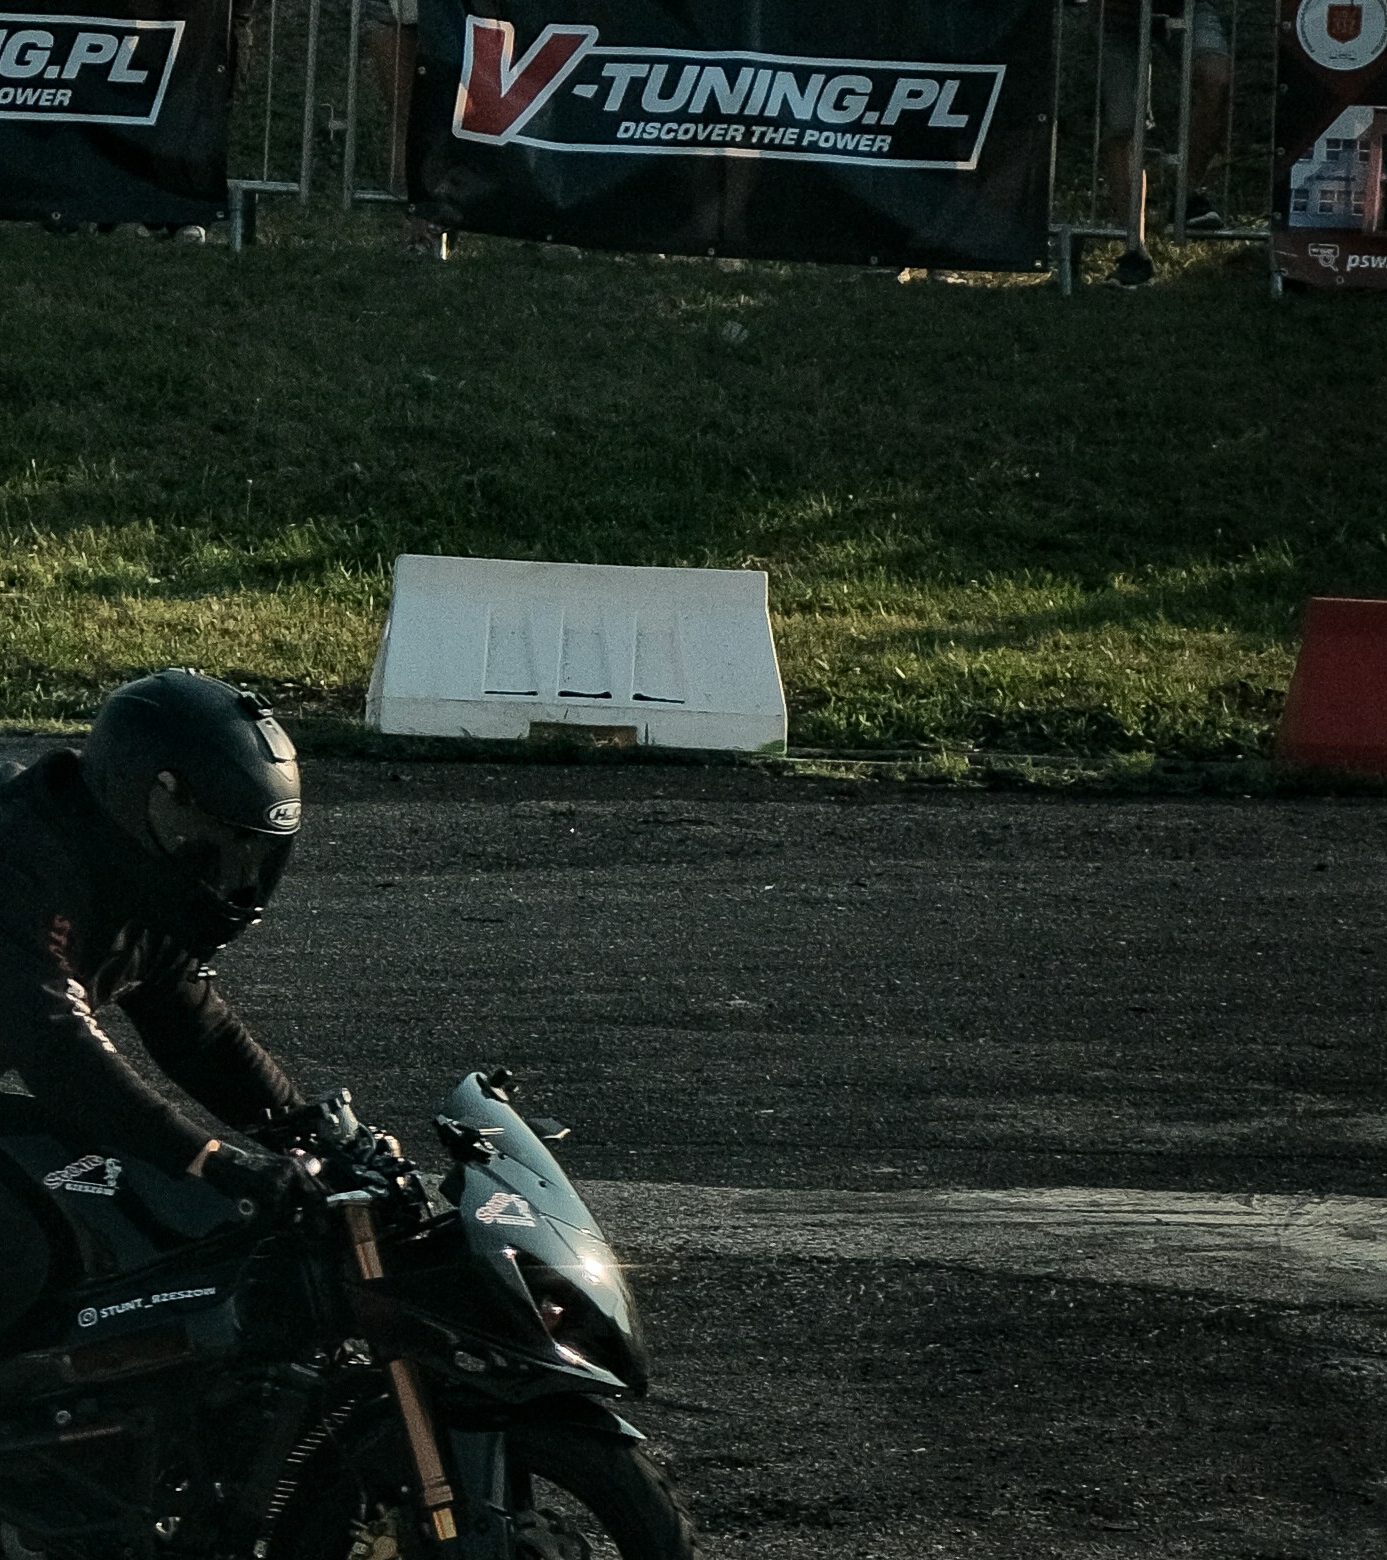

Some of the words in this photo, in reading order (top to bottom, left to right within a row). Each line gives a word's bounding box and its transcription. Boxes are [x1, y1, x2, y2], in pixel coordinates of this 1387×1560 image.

[451, 14, 973, 146] V-TUNING.PL
[616, 121, 744, 144] DISCOVER
[750, 125, 801, 146] THE
[803, 130, 893, 153] POWER
